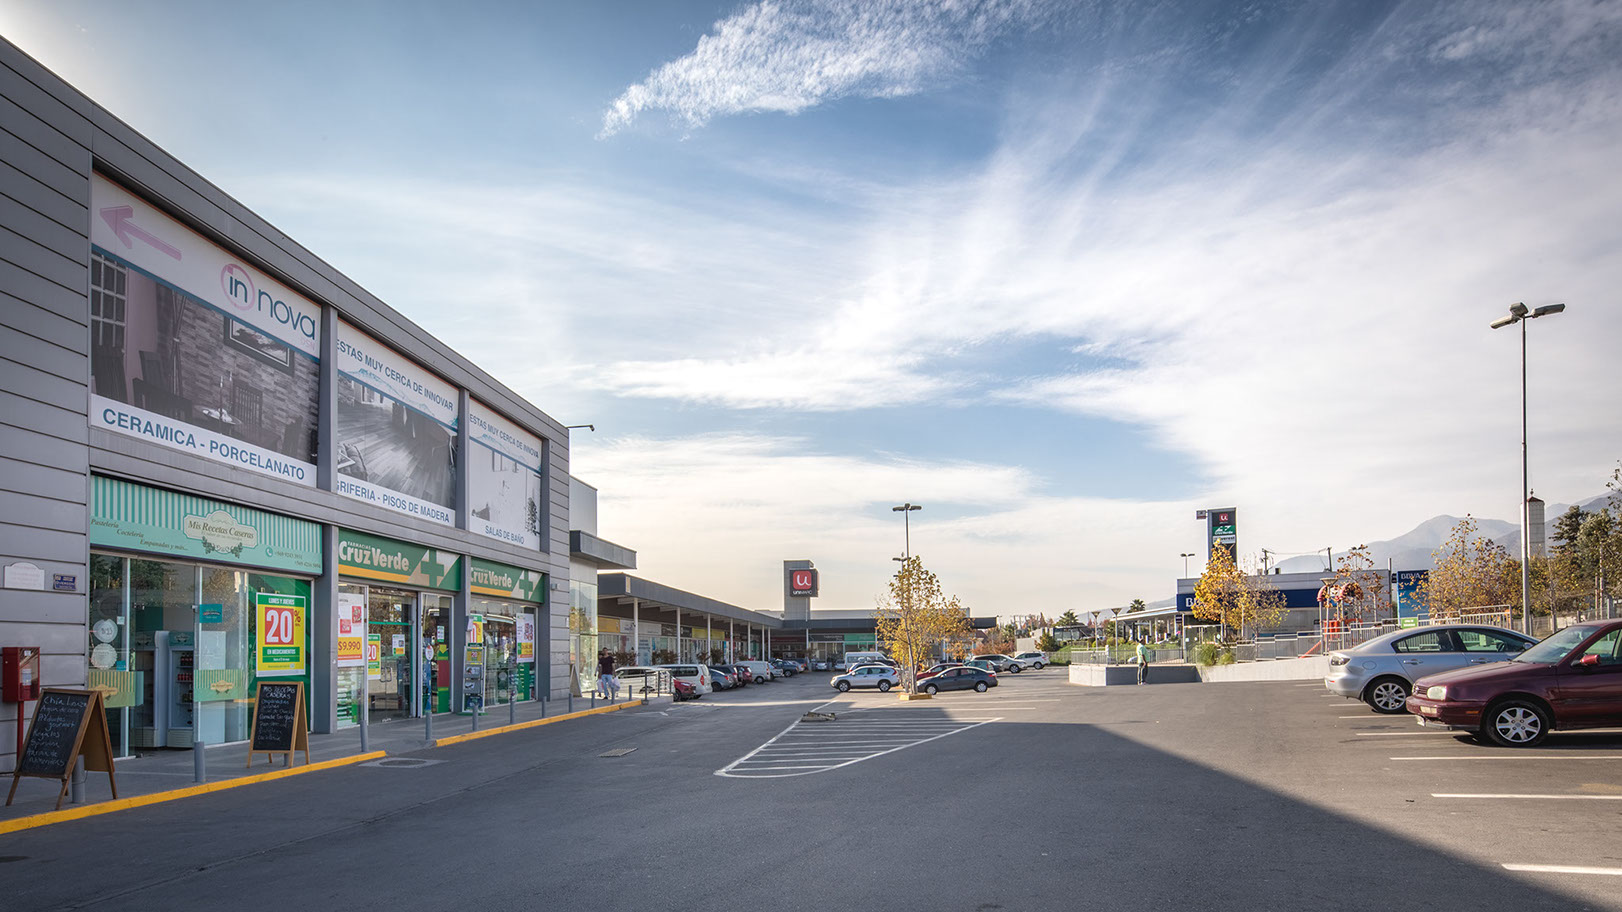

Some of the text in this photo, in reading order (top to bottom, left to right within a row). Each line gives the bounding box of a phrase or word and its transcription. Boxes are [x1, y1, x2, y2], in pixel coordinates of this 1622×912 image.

[365, 354, 383, 372] MUY
[385, 366, 411, 389] CERCA
[413, 382, 422, 396] DE
[424, 388, 453, 411] INNOVAR
[102, 408, 197, 448] CERAMICA
[210, 440, 305, 480] PORCELANATO
[470, 414, 487, 430] ESTAS
[488, 424, 499, 436] MUY
[500, 430, 515, 445] CERCA
[517, 440, 522, 450] DE
[383, 494, 407, 510] PISOS
[409, 502, 418, 513] DE
[421, 506, 449, 522] MADERA
[188, 520, 201, 530] Mis
[202, 522, 228, 534] Recetas
[229, 527, 254, 538] Caseras
[485, 525, 524, 544] SALAS DE BAÑO
[348, 541, 371, 550] FARMACIAS
